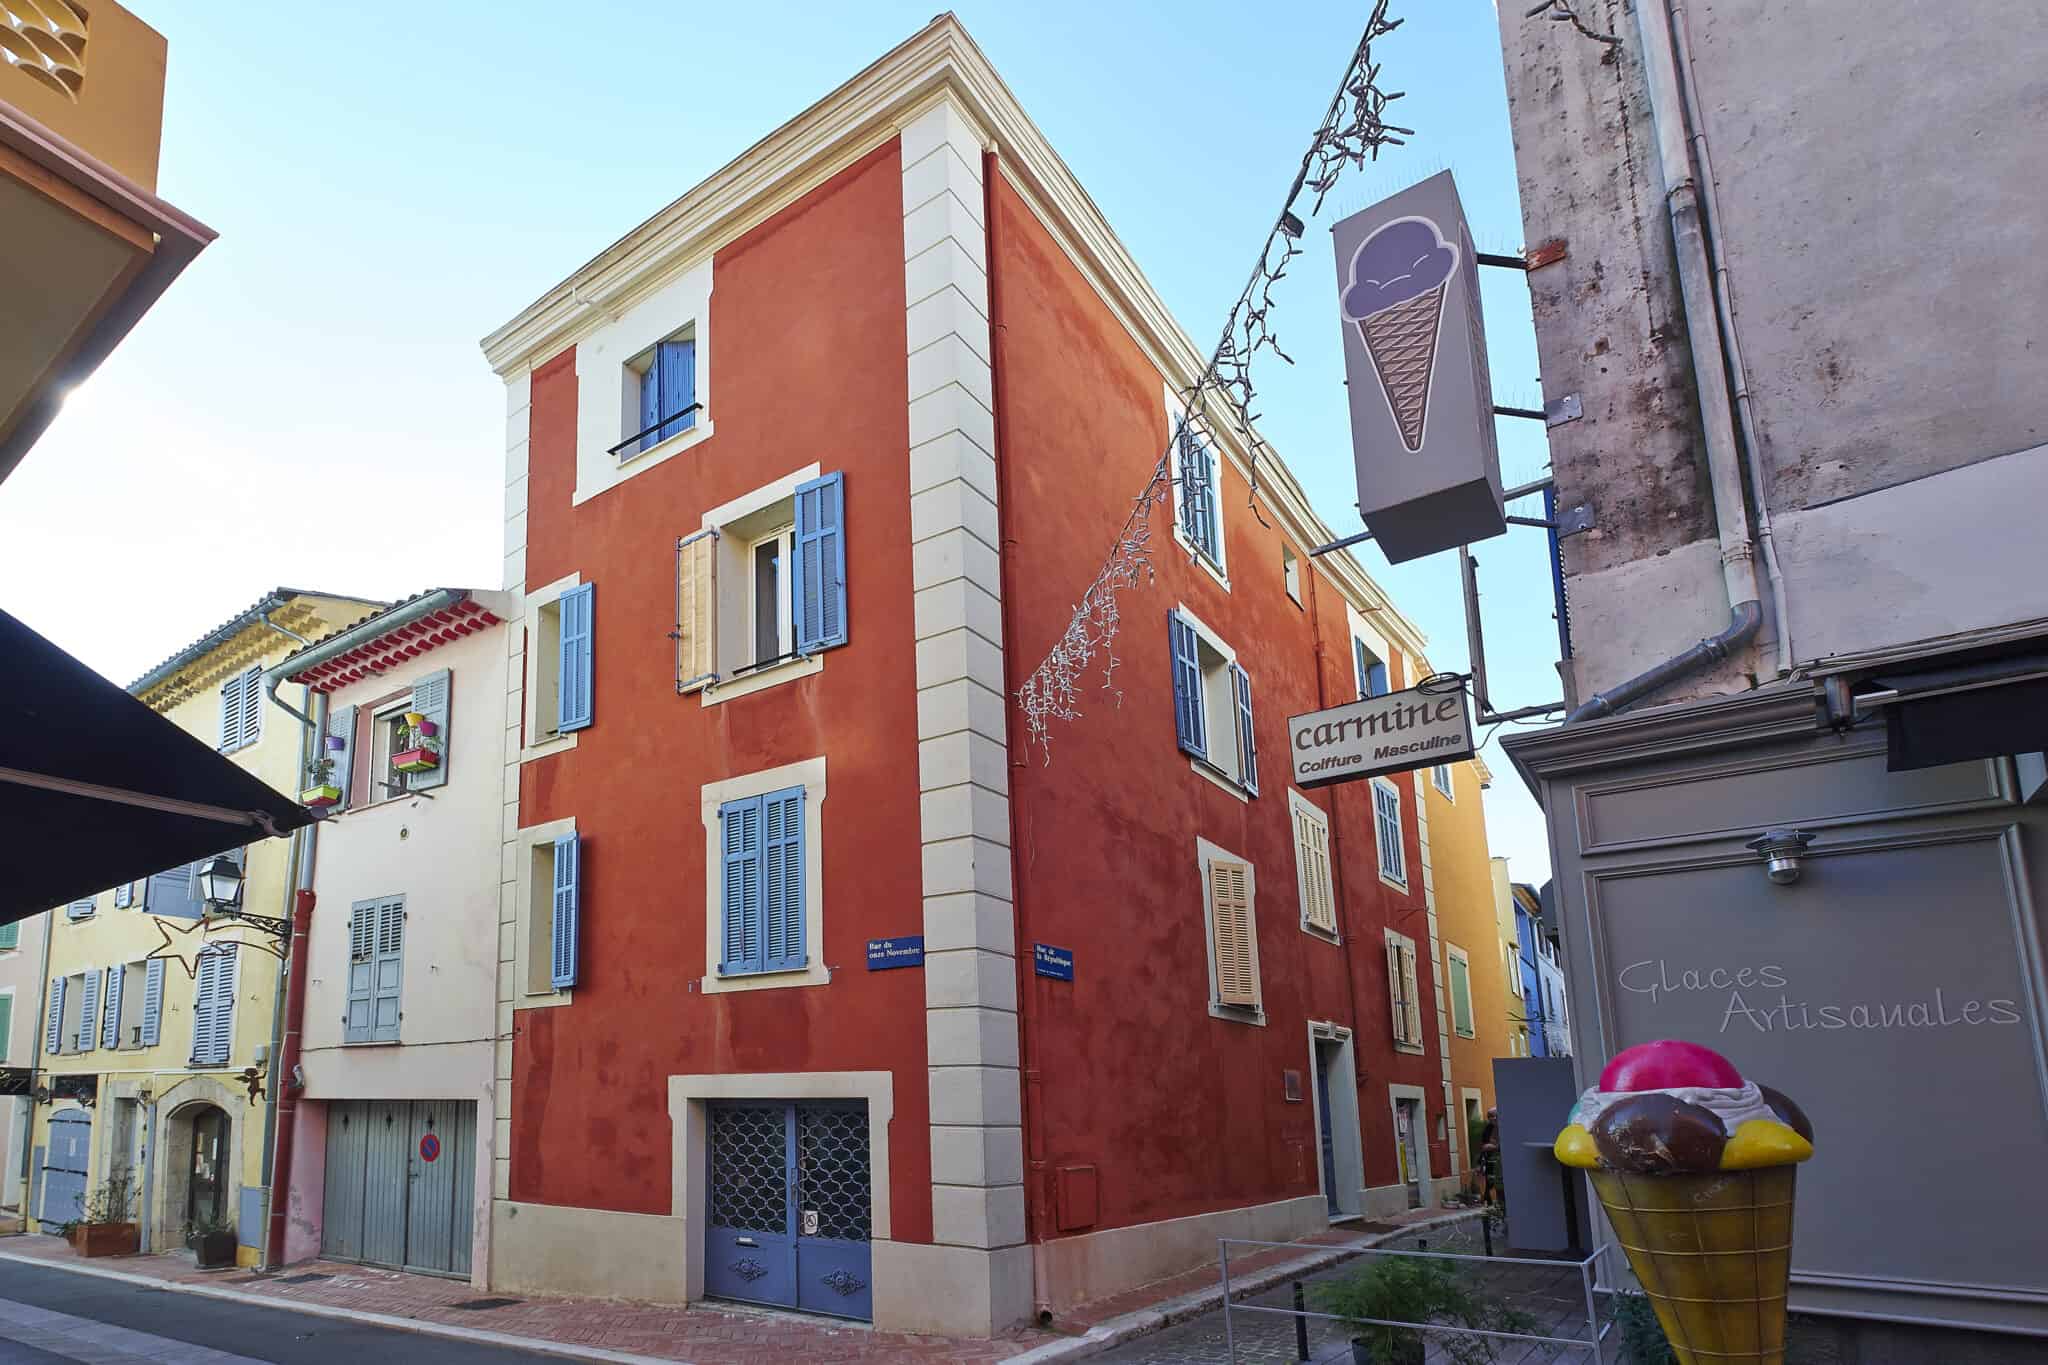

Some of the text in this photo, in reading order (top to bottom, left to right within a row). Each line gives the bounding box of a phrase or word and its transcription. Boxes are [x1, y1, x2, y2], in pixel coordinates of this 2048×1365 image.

[1295, 697, 1460, 751] carmine
[1299, 733, 1462, 775] Coiffure Masculine
[883, 941, 893, 949] du
[887, 946, 921, 957] Novembre
[1618, 959, 1788, 1003] Glaces
[1719, 988, 2021, 1033] Artisanales
